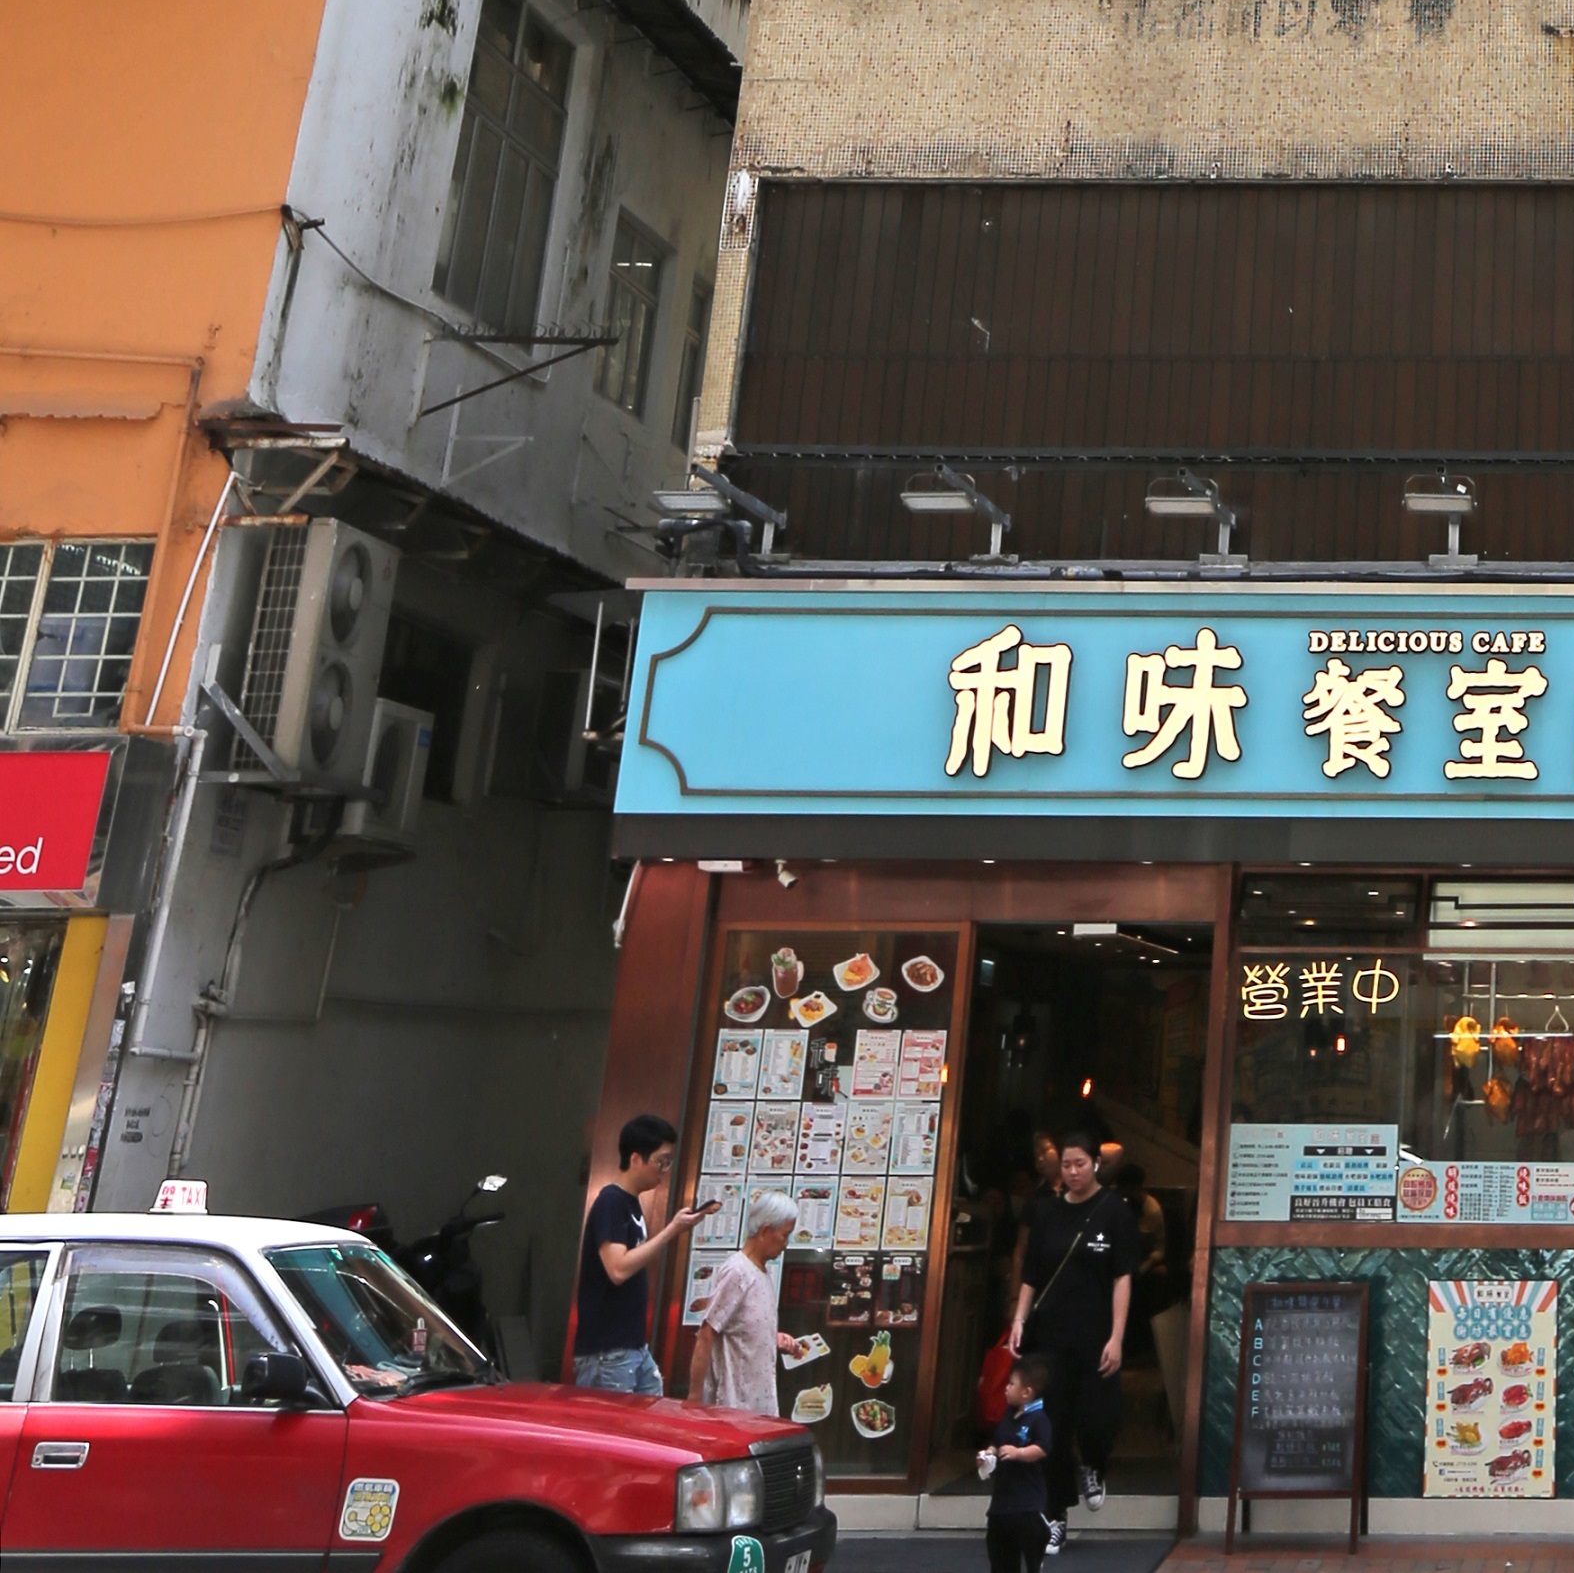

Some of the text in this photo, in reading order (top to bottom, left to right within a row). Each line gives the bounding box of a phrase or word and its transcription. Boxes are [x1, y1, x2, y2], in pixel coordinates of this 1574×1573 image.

[1308, 630, 1546, 653] DELICIOUS CAFE
[944, 623, 1549, 780] 和味餐室
[1242, 958, 1400, 1020] 營業中
[182, 1186, 207, 1206] TAXI
[1255, 1318, 1263, 1331] A
[1254, 1338, 1263, 1349] B
[1252, 1355, 1262, 1366] C
[1252, 1373, 1261, 1385] D
[1251, 1390, 1260, 1401] E
[1251, 1407, 1259, 1419] F
[743, 1546, 751, 1567] 5
